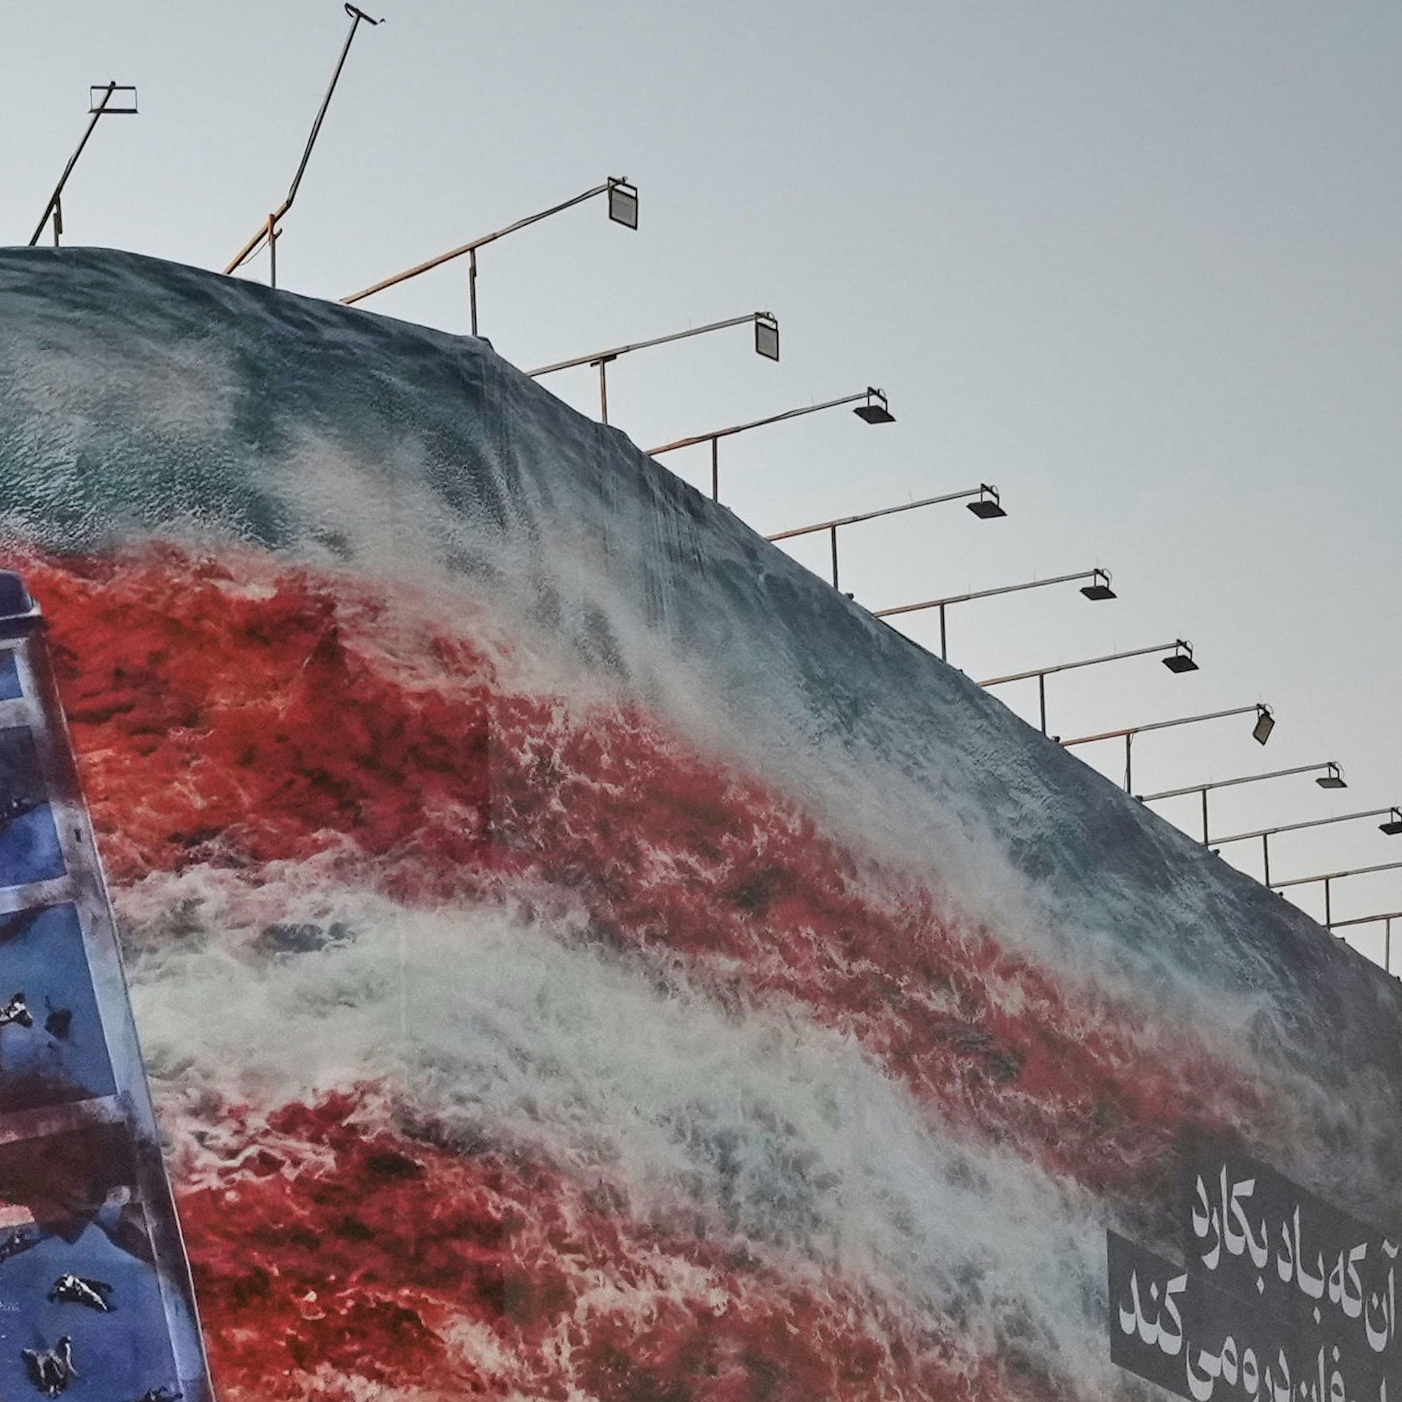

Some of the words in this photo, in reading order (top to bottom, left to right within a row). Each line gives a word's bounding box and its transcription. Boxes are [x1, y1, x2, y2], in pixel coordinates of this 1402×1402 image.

[1191, 1162, 1268, 1295] بکارد
[1277, 1204, 1326, 1325] باد
[1328, 1242, 1368, 1318] که
[1364, 1238, 1399, 1353] آن
